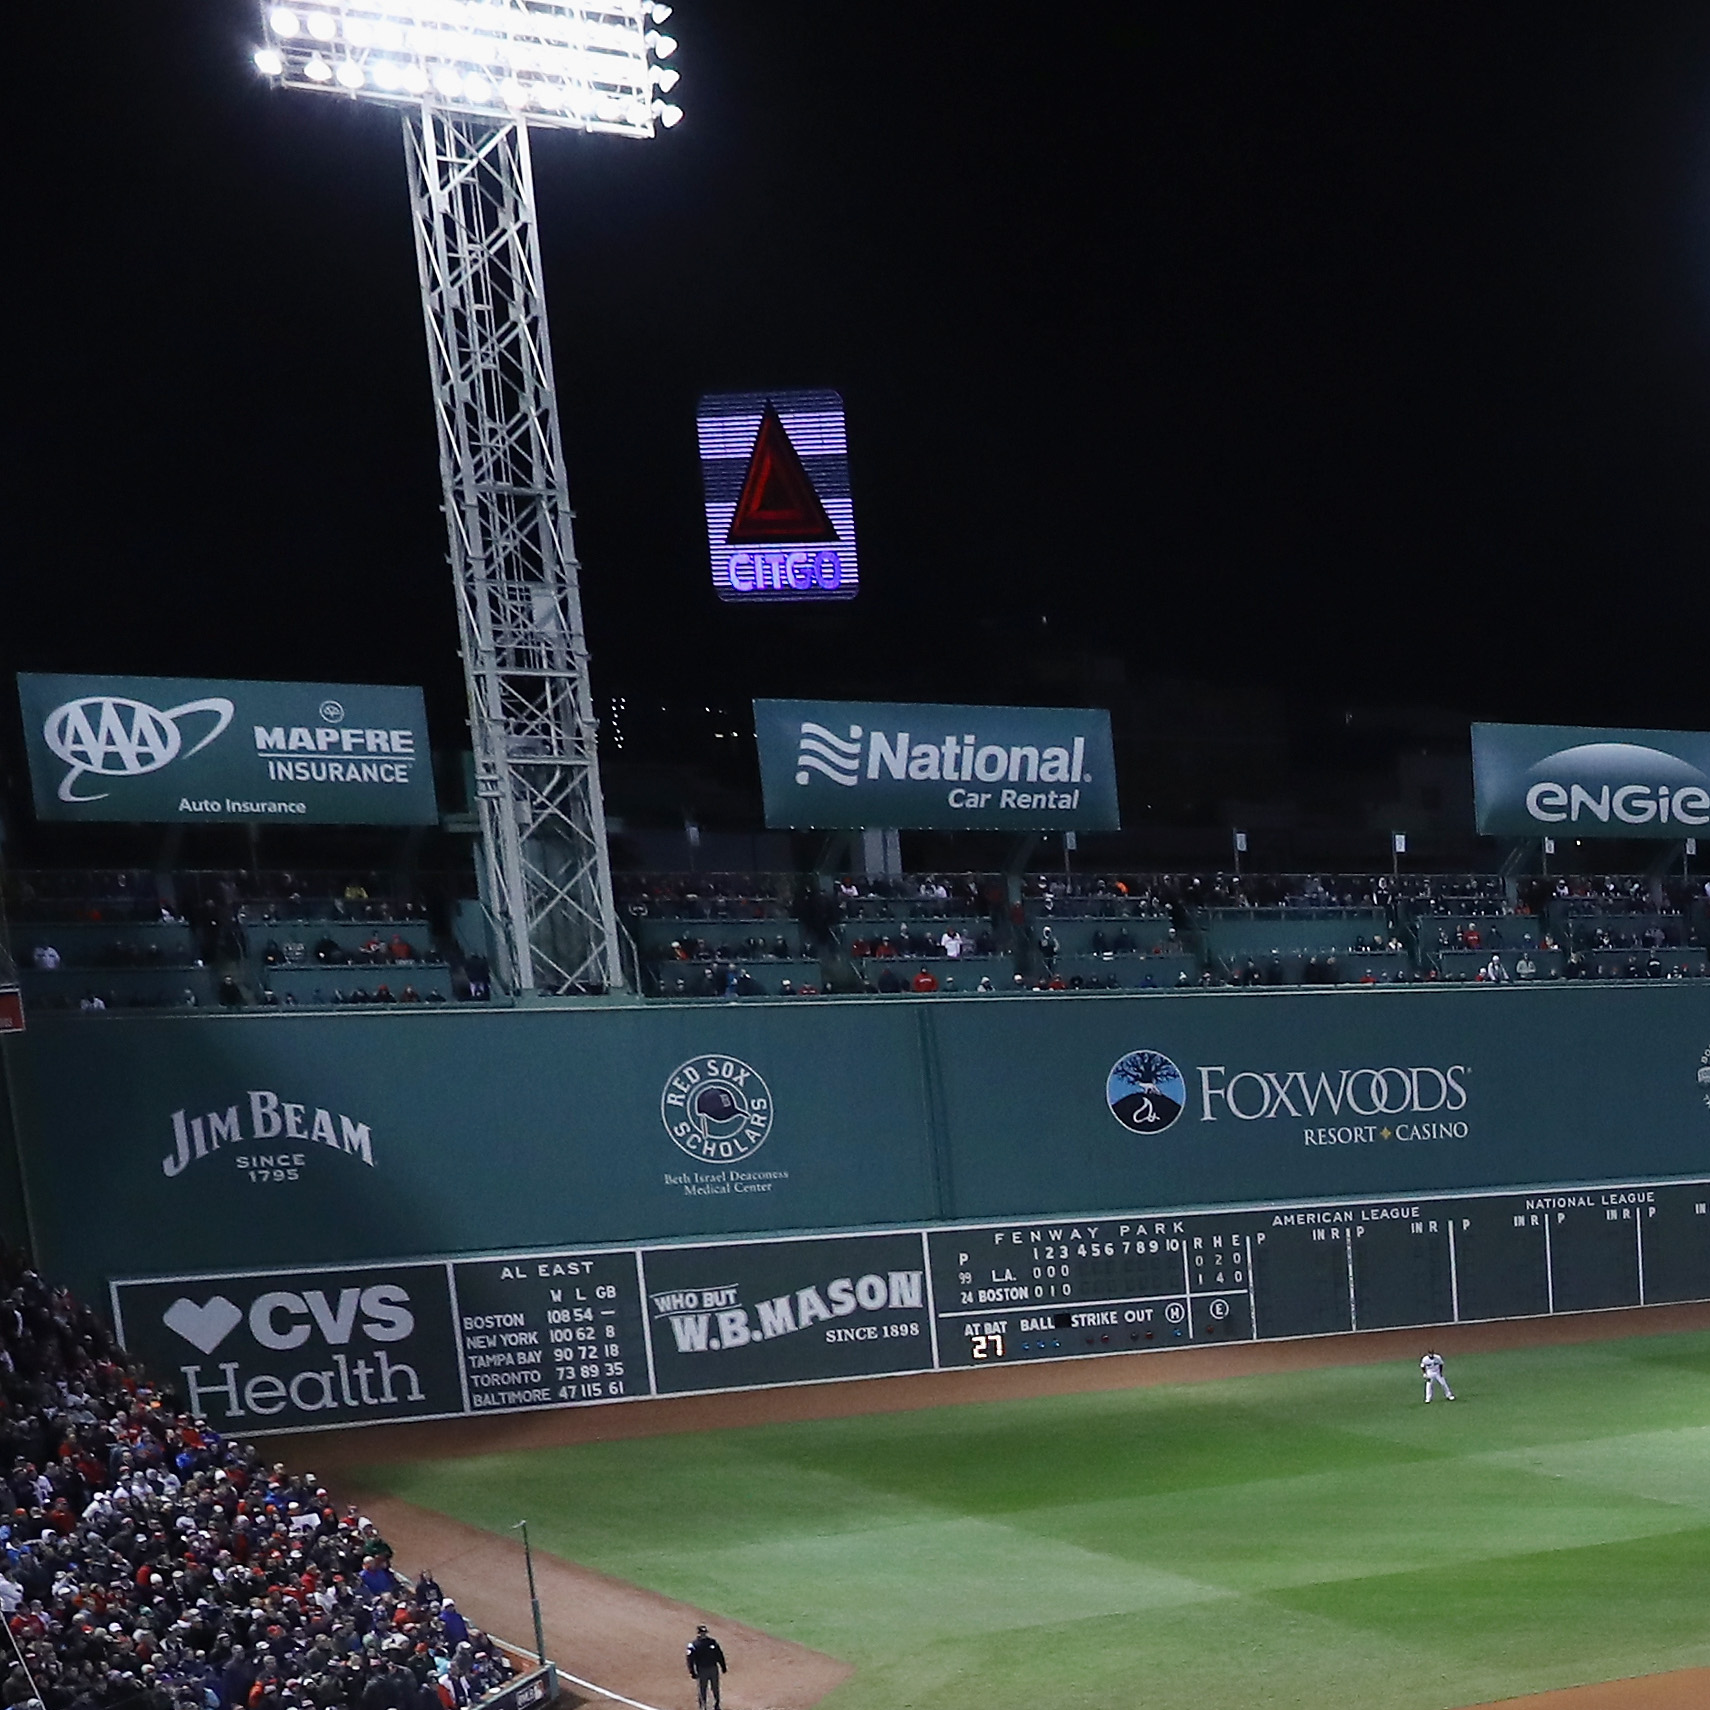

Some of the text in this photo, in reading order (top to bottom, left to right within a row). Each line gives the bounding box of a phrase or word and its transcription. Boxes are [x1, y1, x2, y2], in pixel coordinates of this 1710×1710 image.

[729, 551, 841, 592] CITGO
[63, 699, 169, 773] AAA
[254, 726, 415, 753] MAPFRE
[867, 731, 1085, 783] National
[269, 761, 409, 783] INSURANCE
[179, 799, 306, 814] Auto Insurance
[948, 788, 1079, 810] Car Rental
[666, 1060, 751, 1107] RED SOX
[1197, 1065, 1468, 1122] FOXWOODS
[162, 1090, 375, 1177] JIM BEAM
[673, 1098, 767, 1157] SCHOLARS
[1304, 1122, 1468, 1146] RESORT CASINO
[236, 1155, 305, 1168] SINCE
[249, 1168, 300, 1182] 1795
[664, 1171, 788, 1184] Beth Israel Deaconess
[685, 1183, 772, 1195] Medical Center
[1526, 1192, 1655, 1209] NATIONAL LEAGUE
[1272, 1207, 1420, 1226] AMERICAN LEAGUE
[995, 1222, 1184, 1245] FENWAY PARK
[500, 1261, 593, 1280] AL EAST
[959, 1272, 972, 1283] 99
[551, 1286, 616, 1302] W L GB
[654, 1288, 738, 1312] WHO BUT
[961, 1287, 1028, 1304] 24 BOSTON
[250, 1284, 415, 1350] CVS
[463, 1308, 593, 1330] BOSTON 108 54
[670, 1271, 922, 1352] W.B.MASON
[964, 1309, 1153, 1337] AT BAT BALL STRIKE OUT
[466, 1326, 615, 1349] NEW YORK 100 62 8
[826, 1323, 920, 1343] SINCE 1898
[468, 1344, 619, 1368] TAMPA BAY 90 72 18
[971, 1334, 1004, 1359] 27
[181, 1351, 425, 1420] Health
[471, 1370, 541, 1387] TORONTO
[556, 1367, 575, 1381] 73
[605, 1362, 624, 1376] 35
[472, 1381, 623, 1407] BALTIMORE 47 115 61
